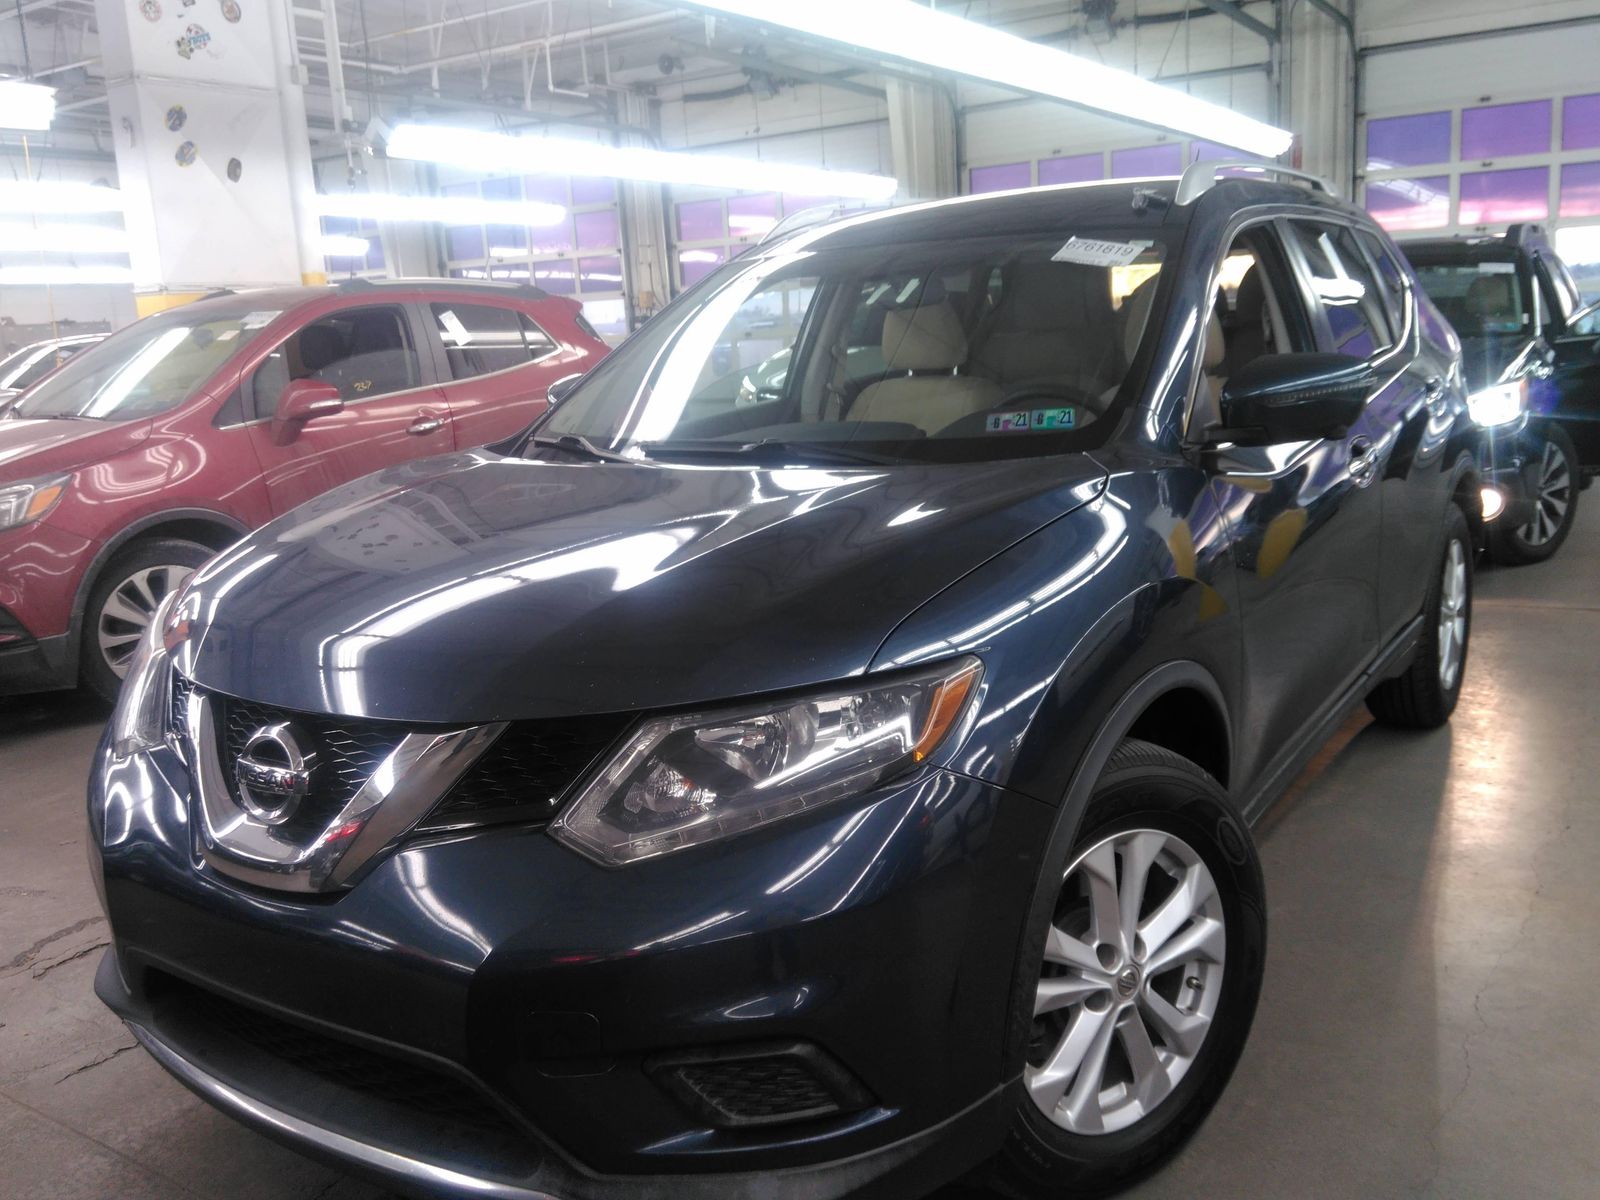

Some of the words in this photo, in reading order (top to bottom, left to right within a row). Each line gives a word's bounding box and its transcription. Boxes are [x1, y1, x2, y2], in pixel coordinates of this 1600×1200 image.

[1065, 241, 1134, 257] 6761819
[1015, 413, 1027, 427] 21
[1060, 410, 1073, 424] 21
[238, 763, 296, 792] NISSAN
